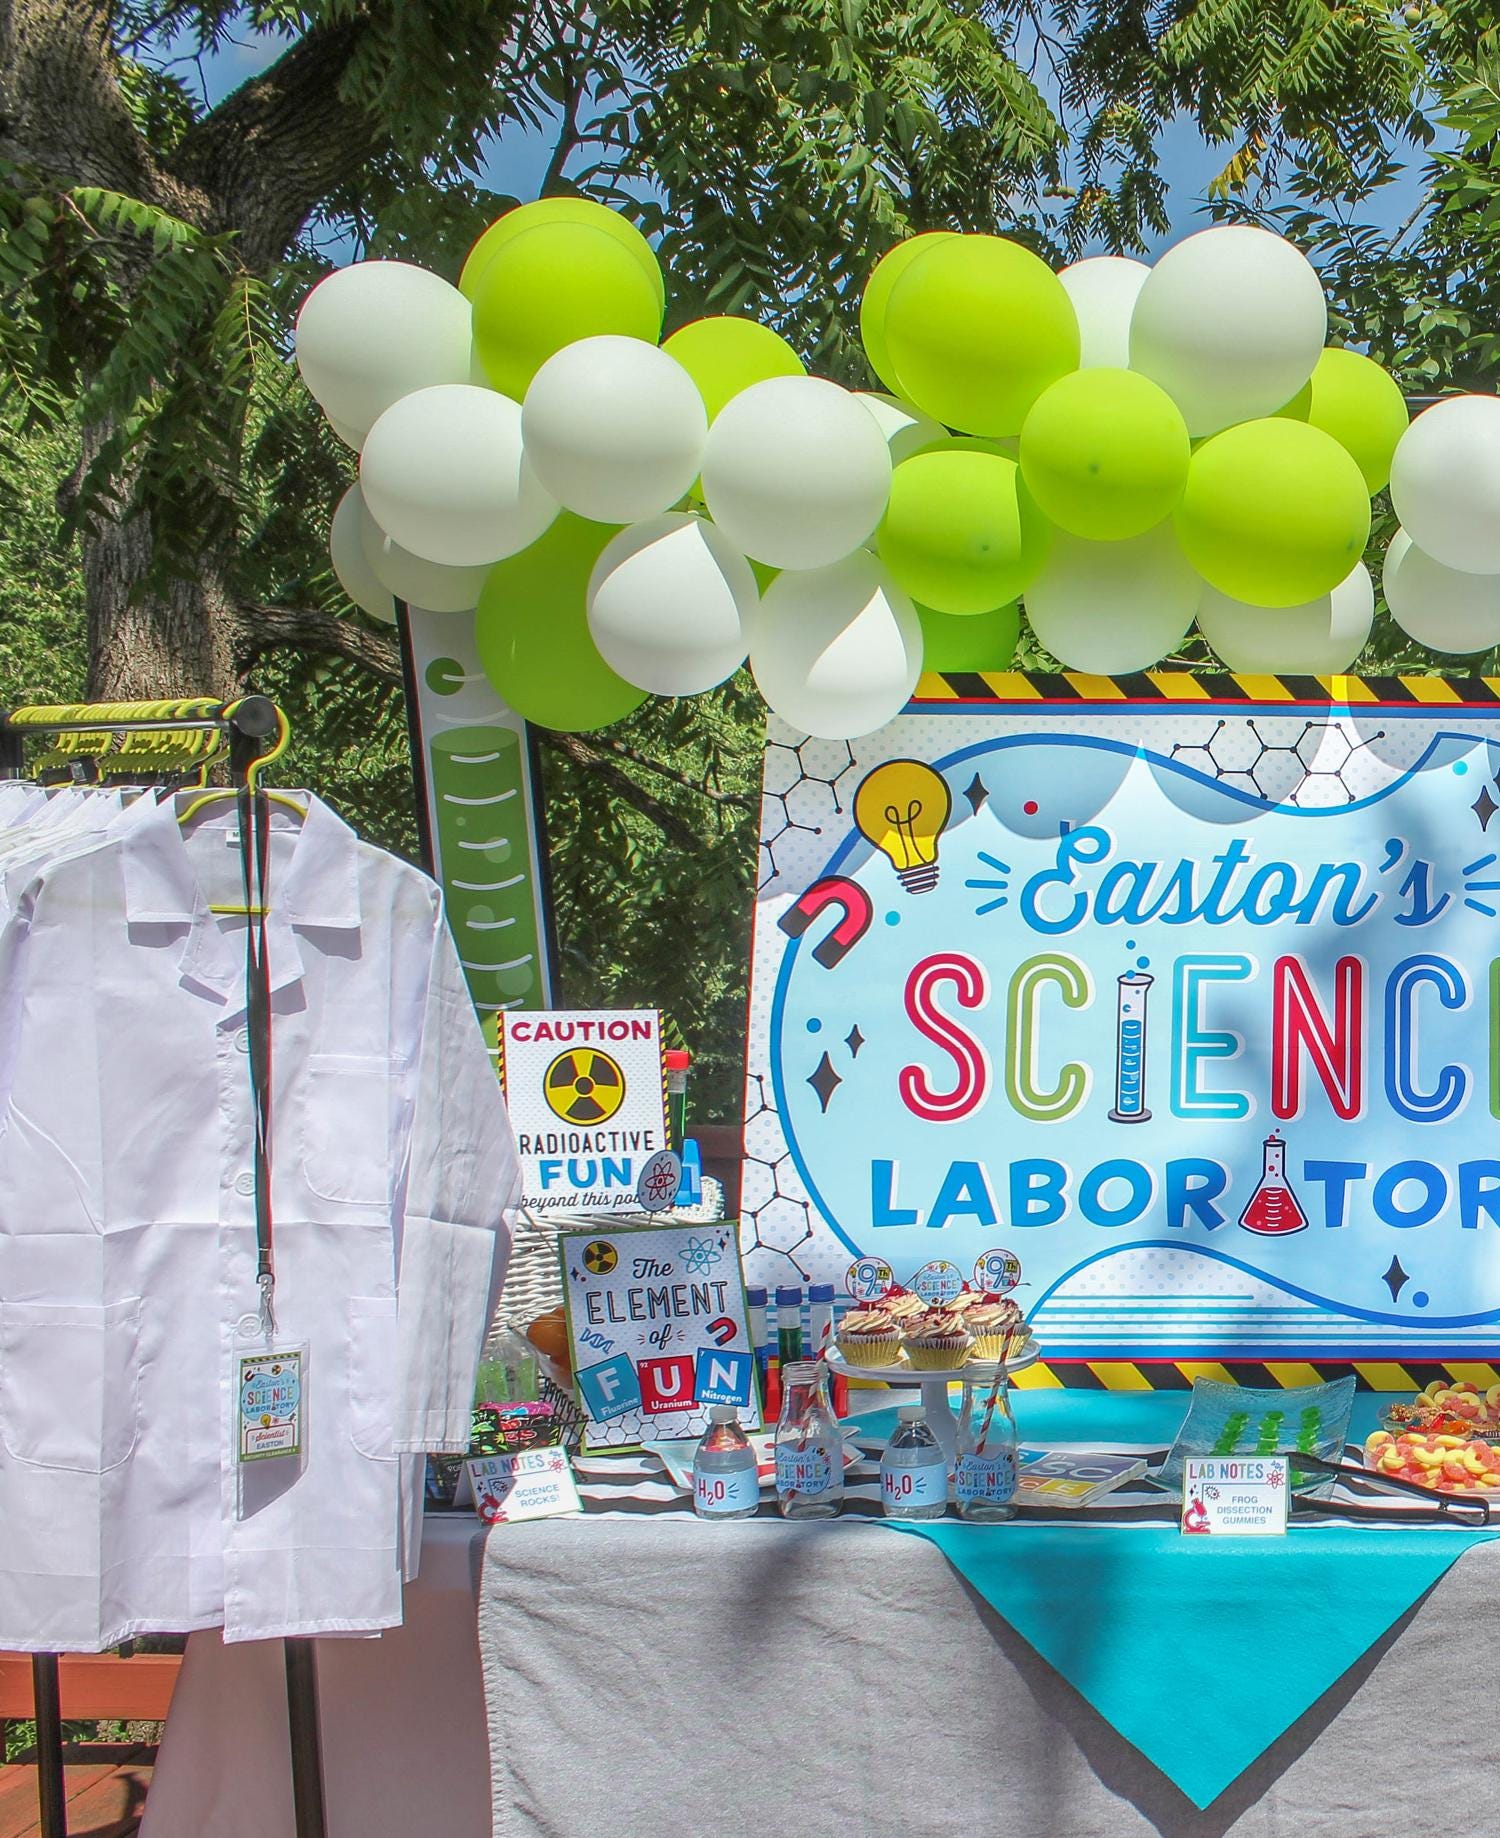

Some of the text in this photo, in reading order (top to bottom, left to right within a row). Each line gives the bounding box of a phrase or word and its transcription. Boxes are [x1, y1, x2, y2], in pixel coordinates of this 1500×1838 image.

[1020, 821, 1452, 934] Easton's
[511, 1020, 651, 1042] CAUTION
[520, 1130, 654, 1155] RADIOACTIVE
[539, 1157, 632, 1189] FUN
[522, 1194, 579, 1213] beyond
[583, 1191, 610, 1206] this
[633, 1258, 673, 1279] The
[878, 1269, 889, 1278] Th
[1006, 1261, 1017, 1271] Th
[586, 1281, 728, 1325] ELEMENT
[649, 1323, 673, 1350] of
[651, 1399, 692, 1410] Uranium
[701, 1389, 743, 1404] Nitrogen
[601, 1397, 638, 1417] Fluorine
[256, 1440, 284, 1450] EASTON
[471, 1463, 497, 1478] LAB
[502, 1454, 545, 1473] NOTES
[1190, 1464, 1263, 1479] LAB NOTES
[515, 1483, 560, 1498] SCIENCE
[1232, 1496, 1258, 1504] FROG
[1217, 1506, 1272, 1514] DISSECTION
[1222, 1516, 1266, 1524] GUMMIES
